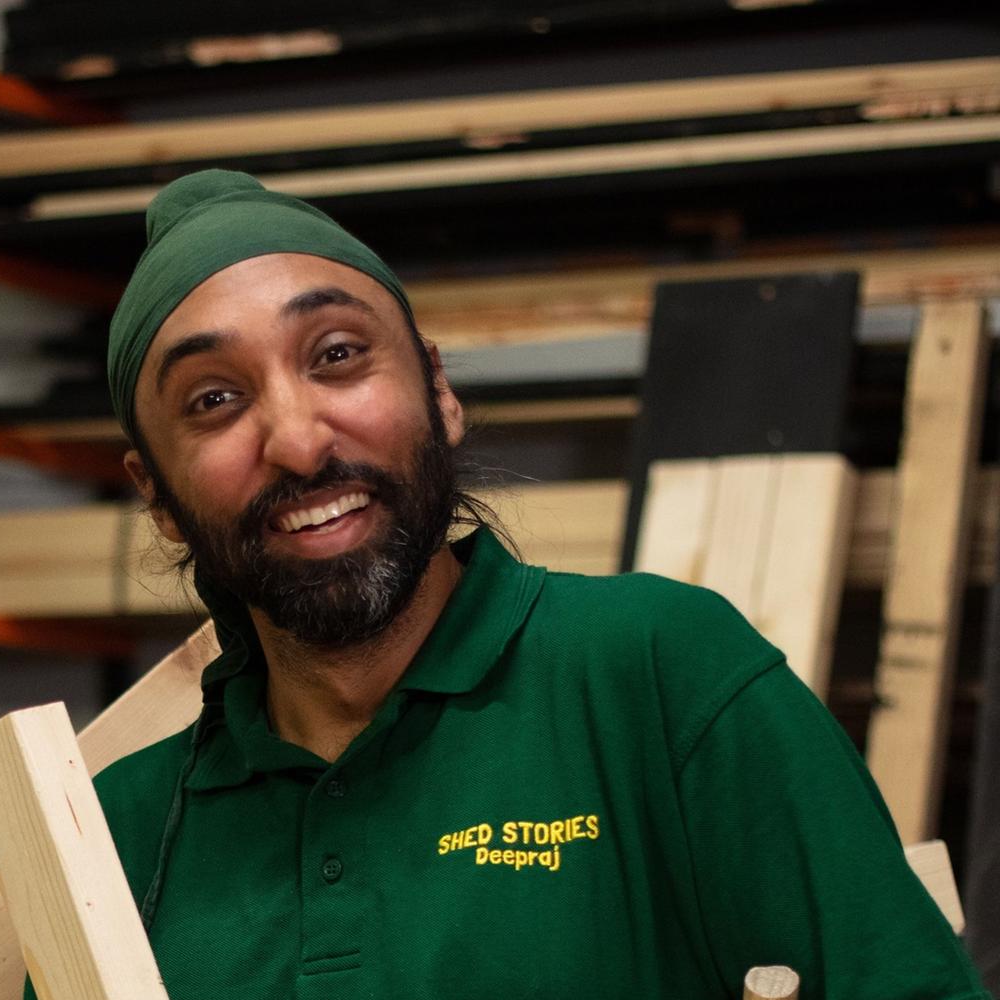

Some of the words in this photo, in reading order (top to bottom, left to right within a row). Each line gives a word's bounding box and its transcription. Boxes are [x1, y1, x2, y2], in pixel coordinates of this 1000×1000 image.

[438, 823, 493, 855] SHED
[502, 815, 599, 845] STORIES
[476, 846, 560, 871] Deepraj
